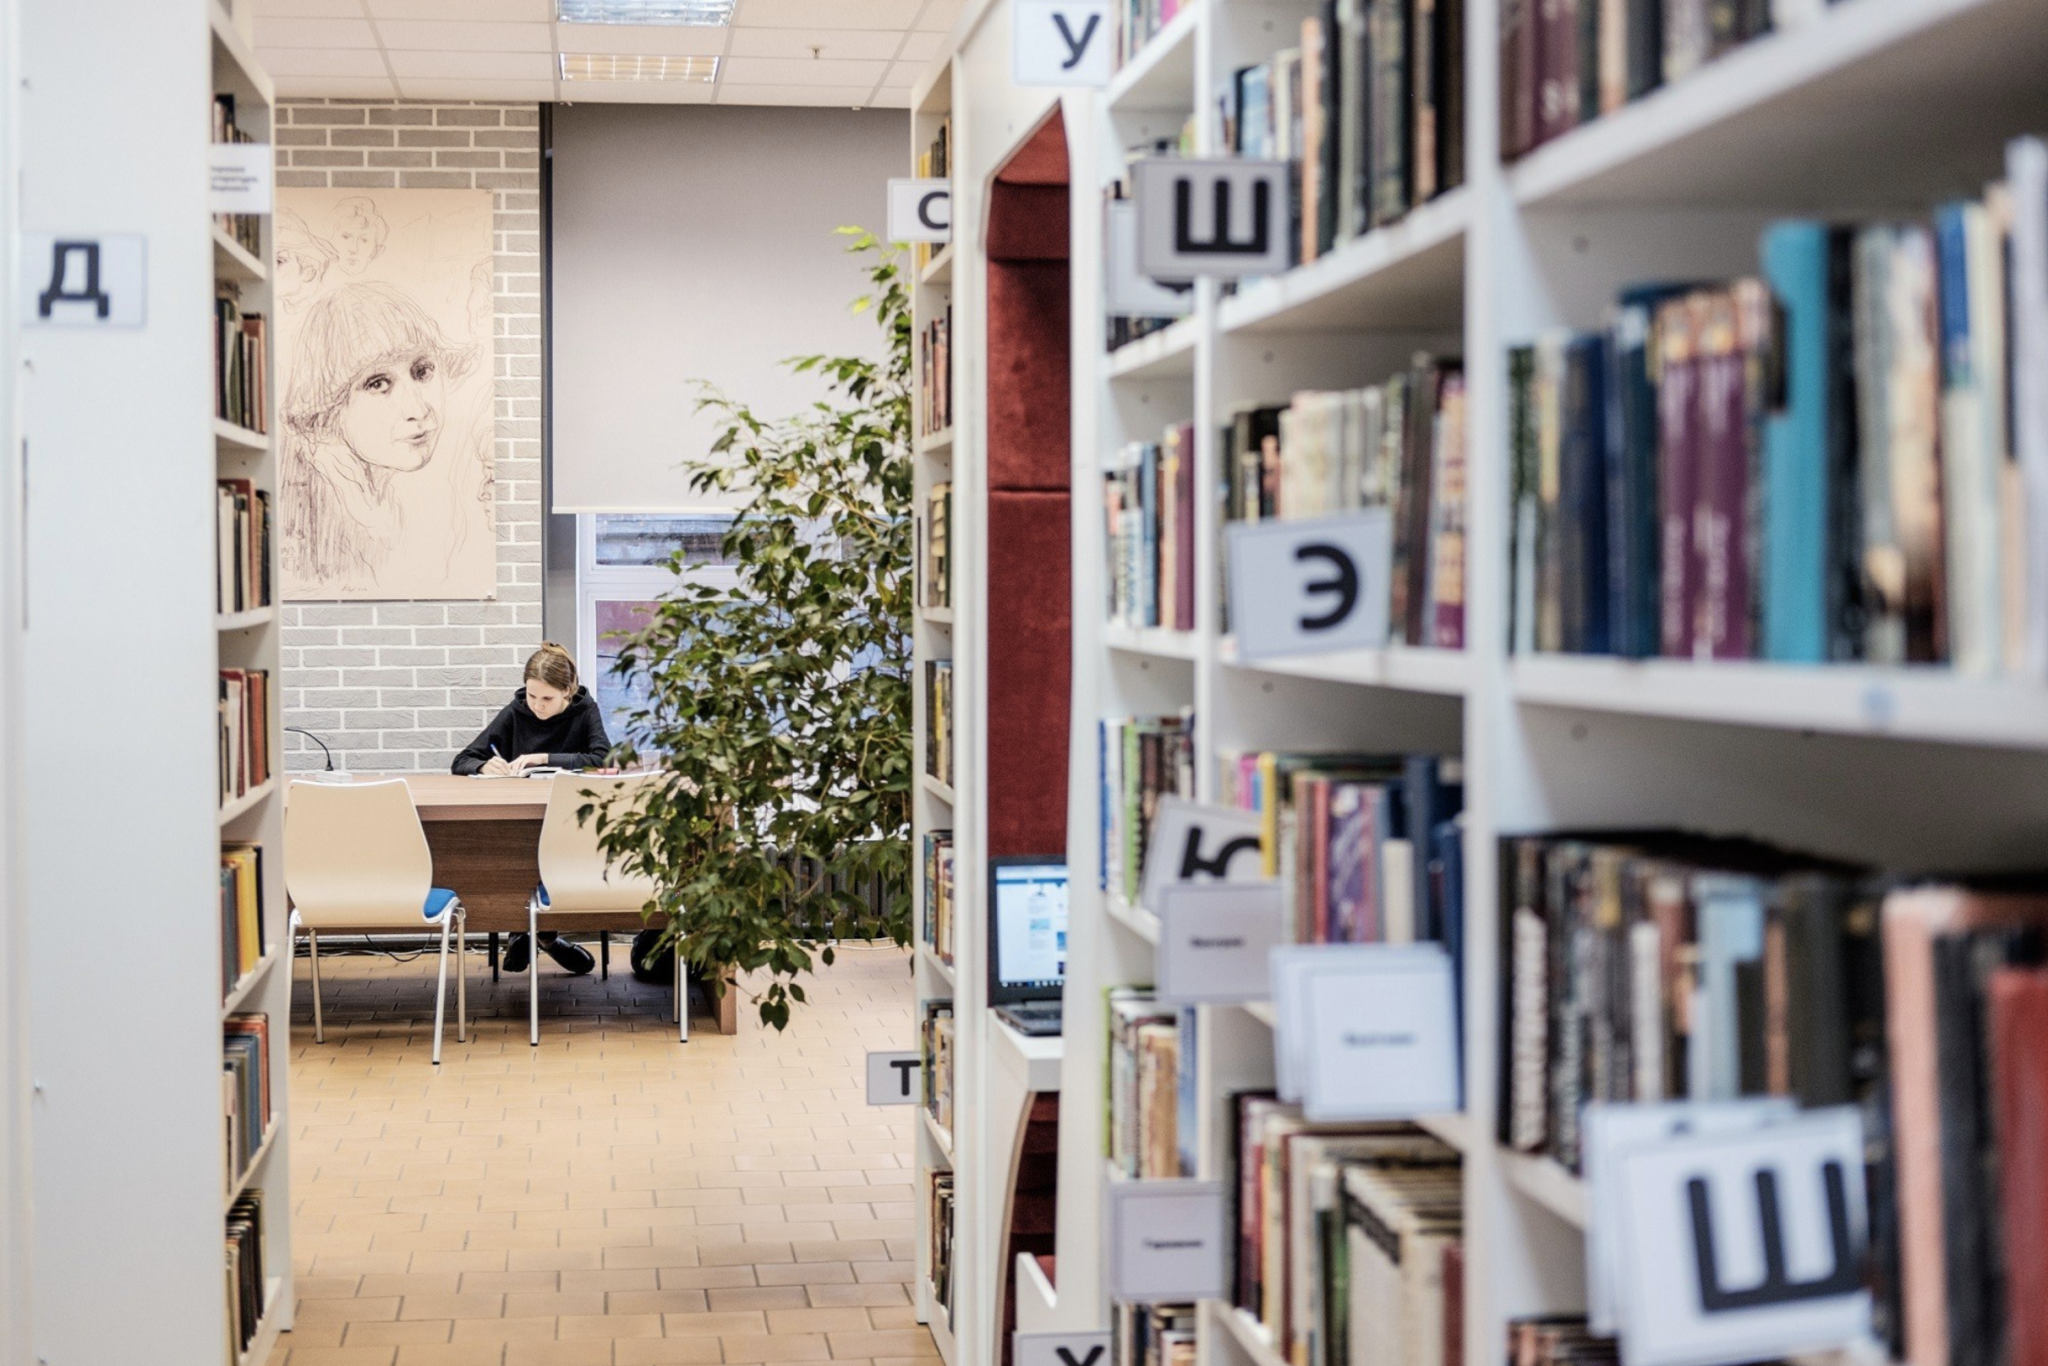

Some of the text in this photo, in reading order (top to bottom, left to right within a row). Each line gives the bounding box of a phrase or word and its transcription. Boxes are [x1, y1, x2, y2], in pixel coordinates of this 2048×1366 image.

[1052, 14, 1100, 69] У
[917, 190, 950, 231] С
[1175, 178, 1269, 254] Ш
[39, 241, 110, 318] Д
[1296, 543, 1358, 631] Э
[889, 1060, 922, 1097] Т
